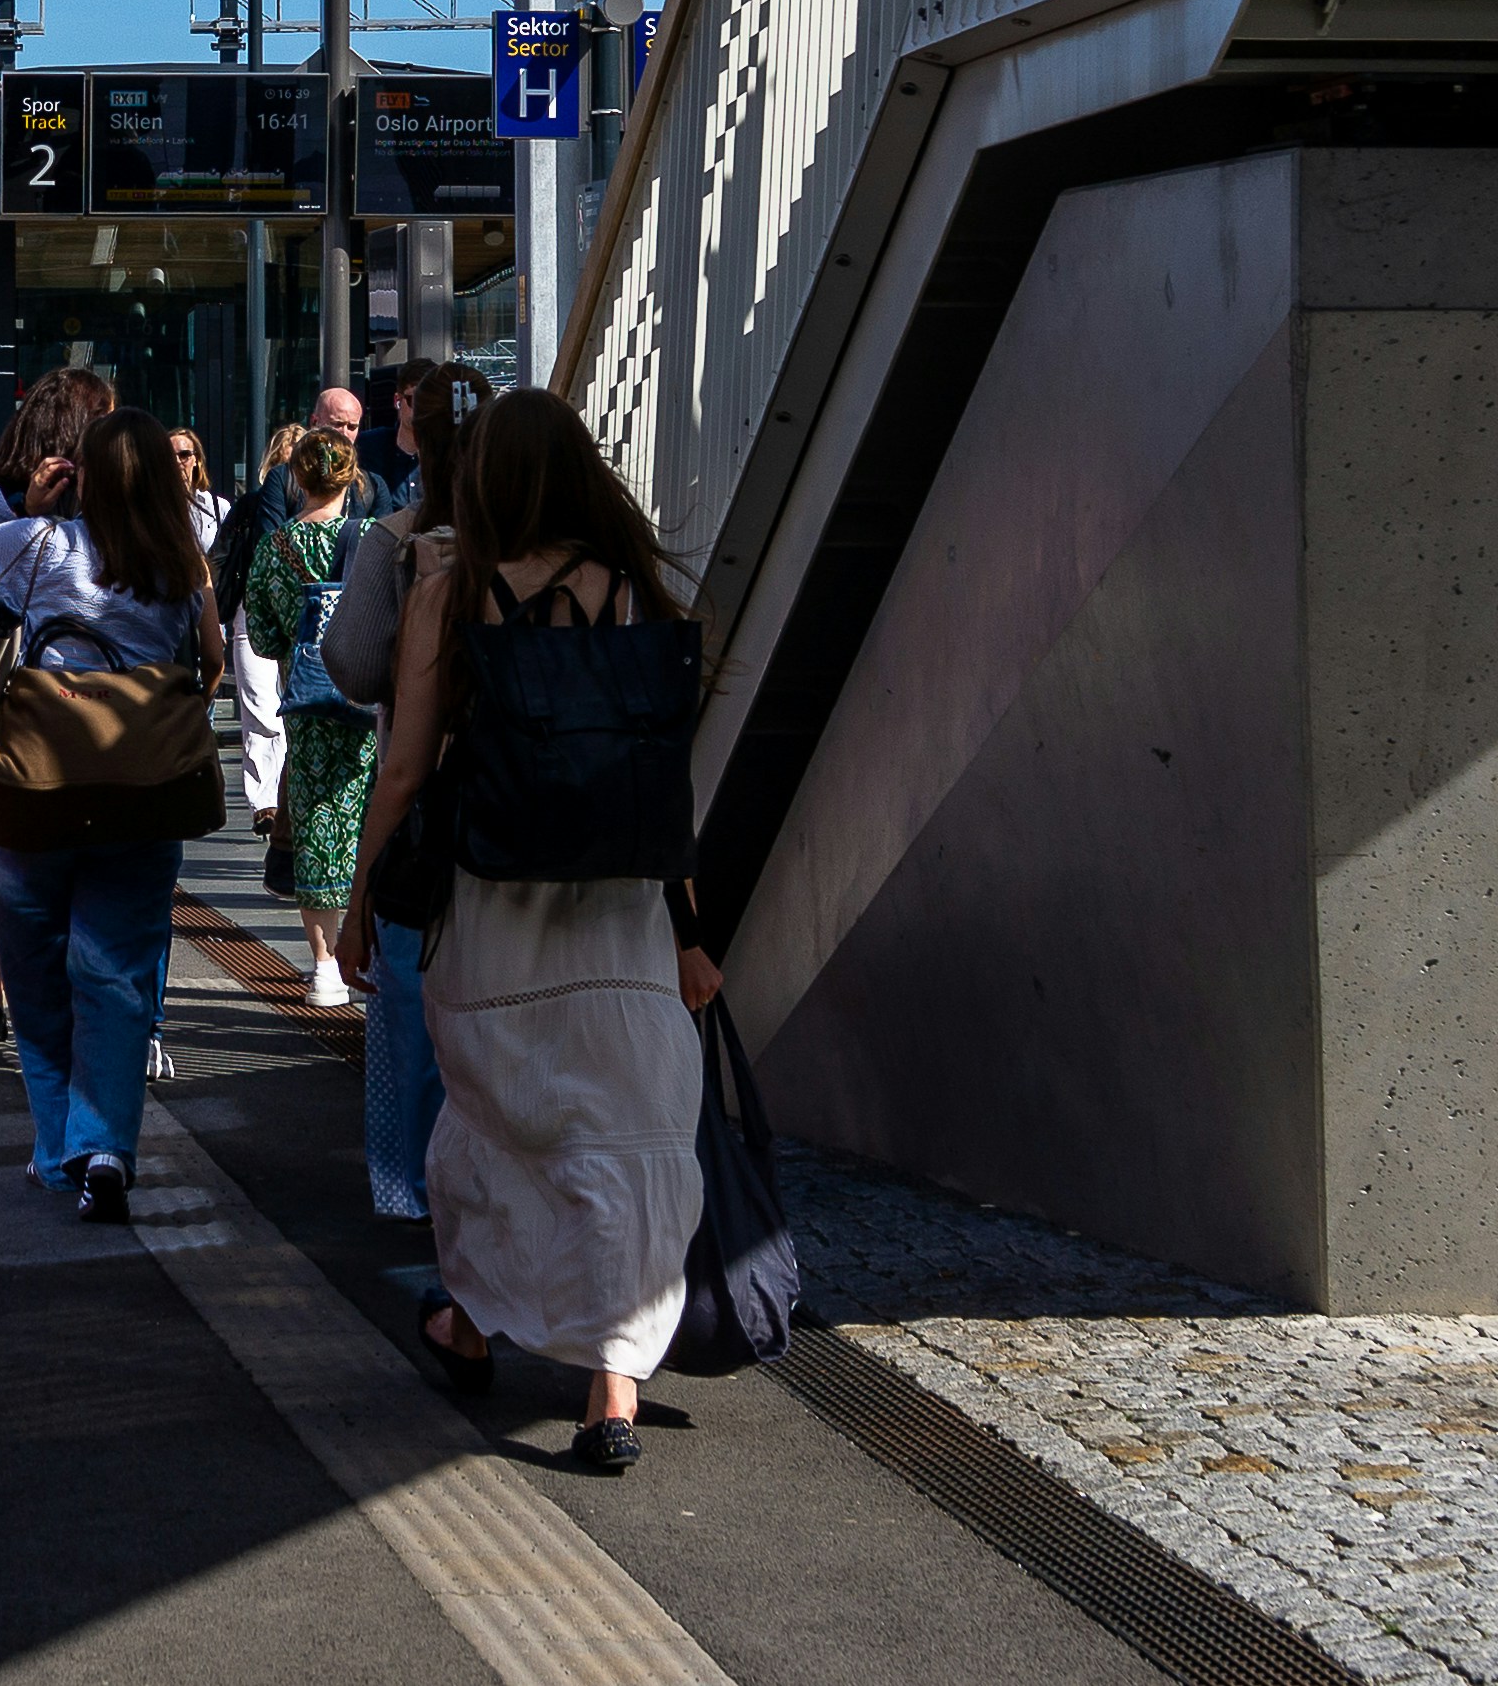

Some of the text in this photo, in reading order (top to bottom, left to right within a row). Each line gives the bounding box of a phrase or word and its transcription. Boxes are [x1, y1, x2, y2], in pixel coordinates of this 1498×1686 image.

[507, 16, 569, 36] Sektor
[507, 38, 569, 57] Sector
[519, 67, 557, 119] H
[22, 97, 61, 115] Spor
[21, 115, 67, 130] Track
[109, 112, 308, 131] Skien 16:41
[376, 114, 493, 136] Oslo Airport
[28, 143, 56, 186] 2
